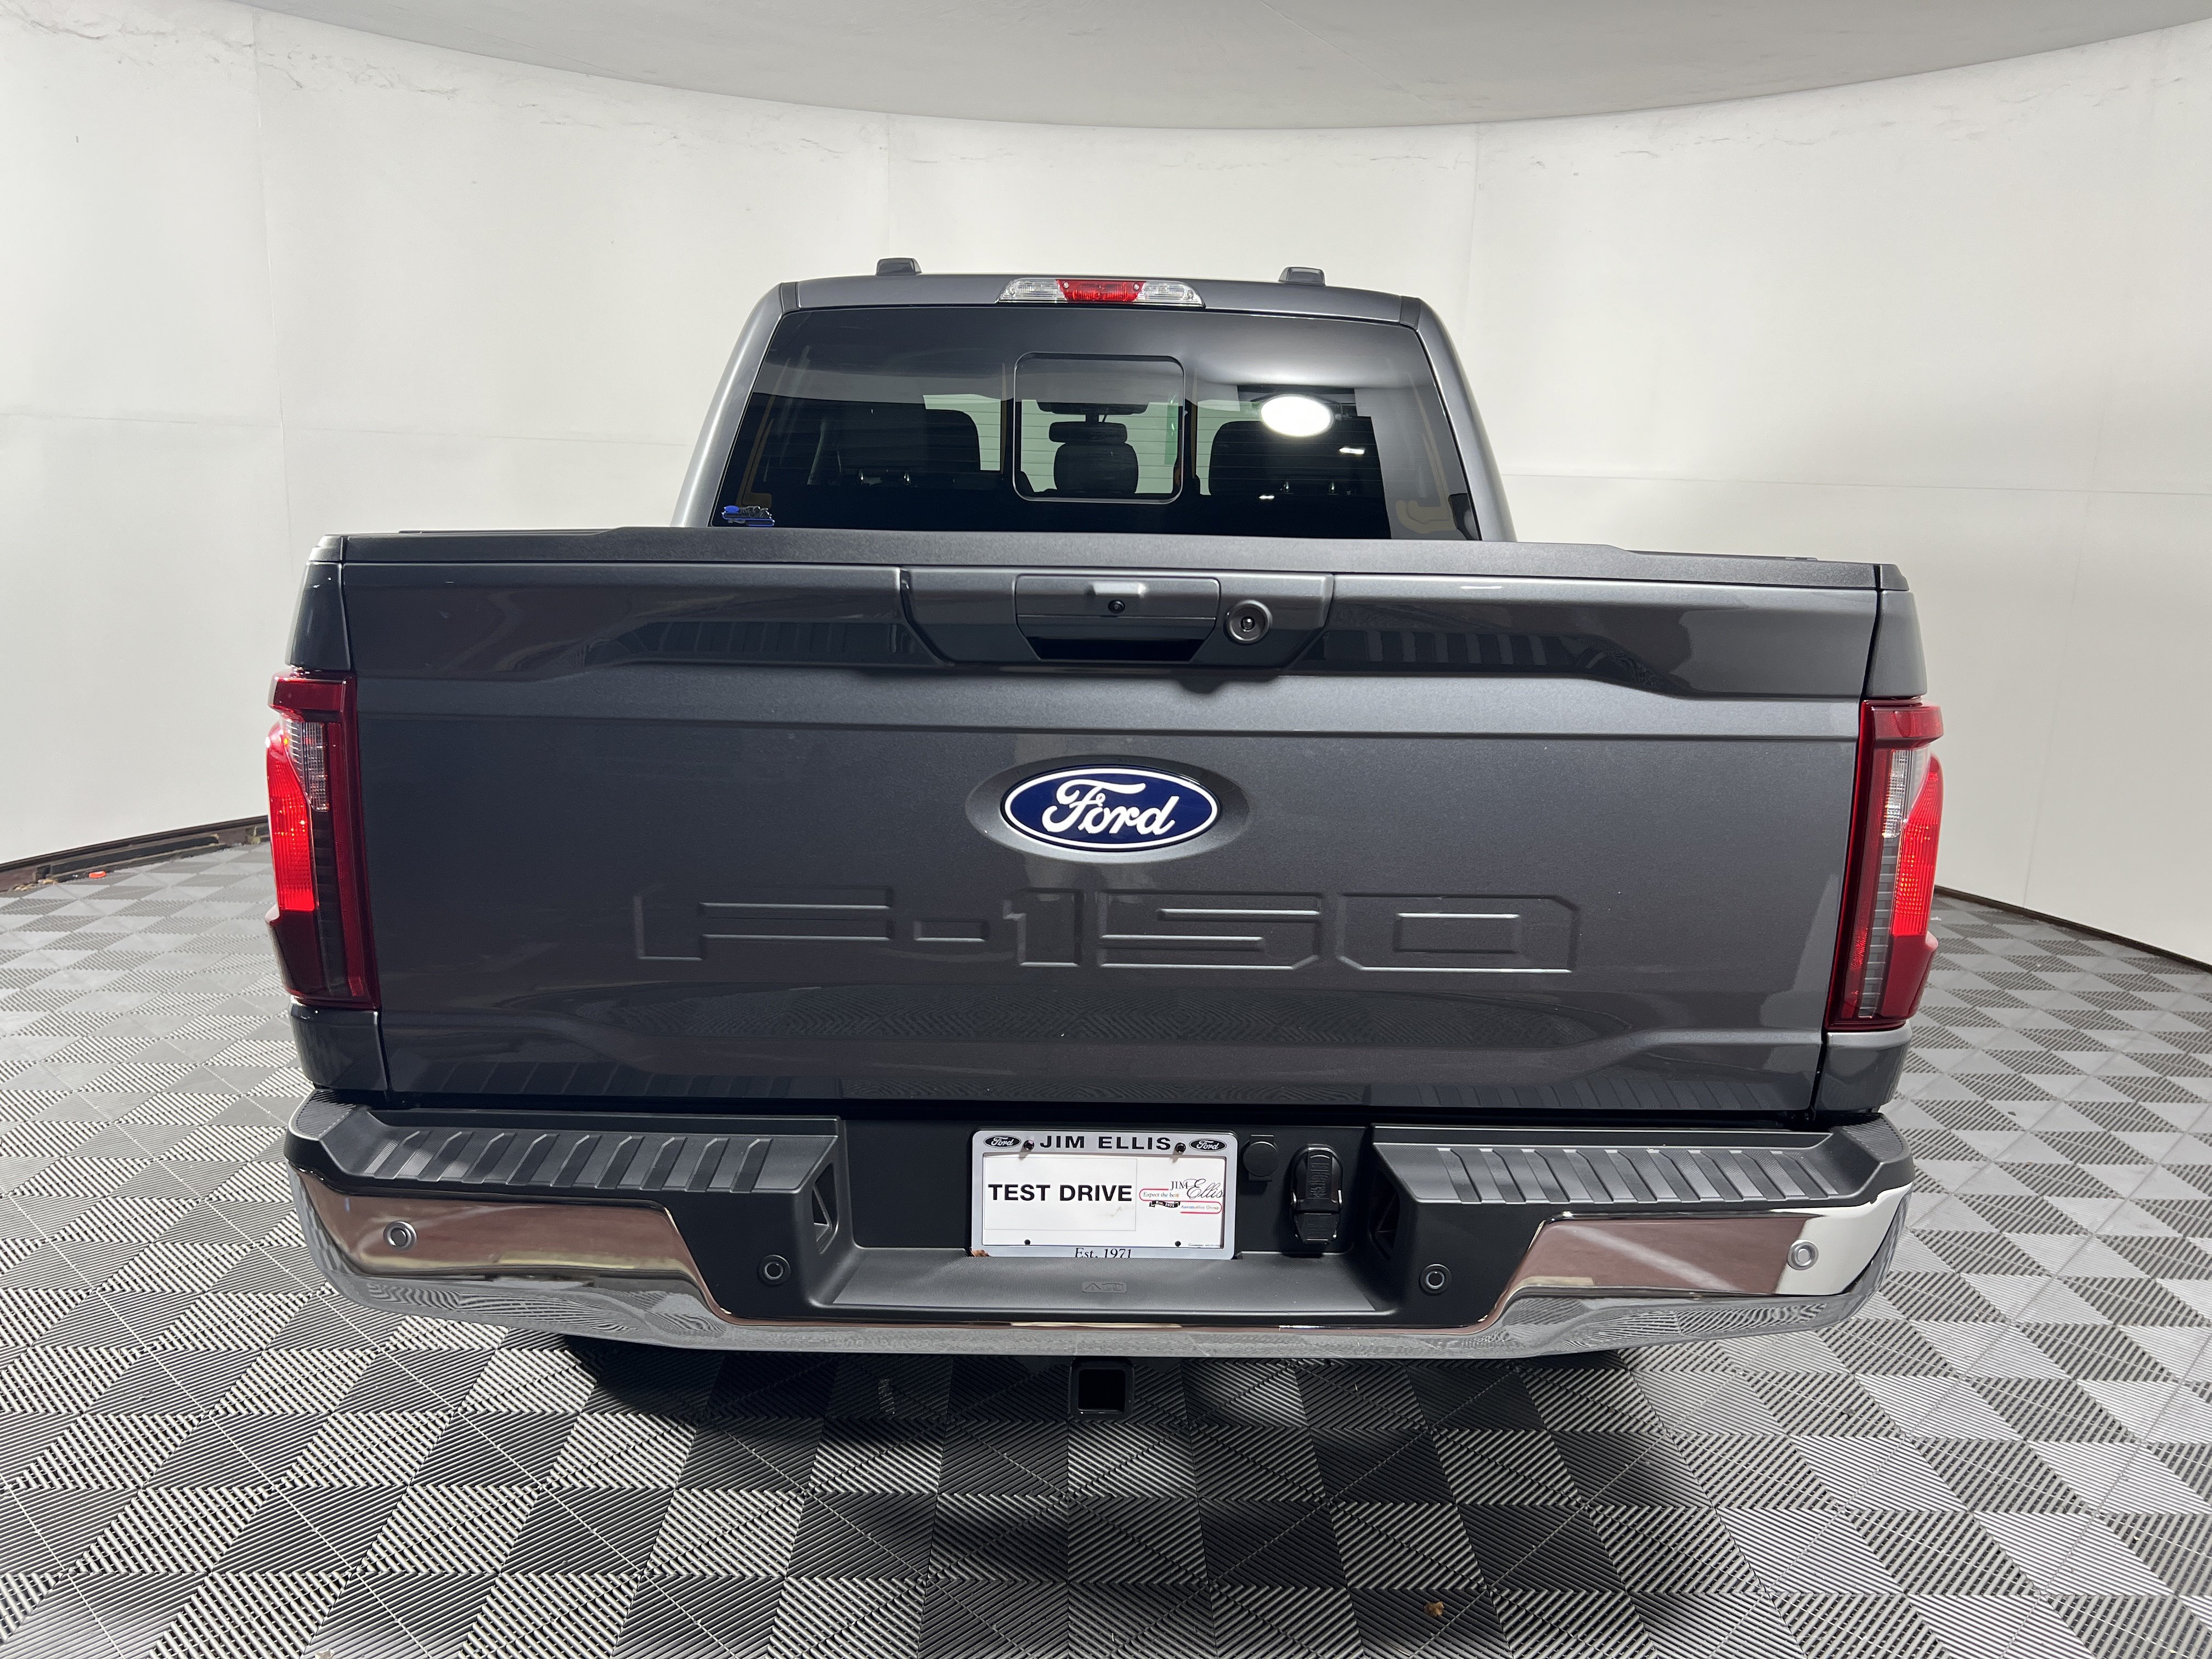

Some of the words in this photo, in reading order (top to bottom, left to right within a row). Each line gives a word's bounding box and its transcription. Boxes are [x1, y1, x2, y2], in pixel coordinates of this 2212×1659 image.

[1042, 779, 1180, 836] Ford
[633, 884, 1581, 974] F-150
[991, 1136, 1015, 1147] Ford
[1040, 1135, 1085, 1149] JIM
[1098, 1136, 1171, 1150] ELLIS
[1195, 1139, 1220, 1151] Ford
[988, 1184, 1051, 1201] TEST
[1059, 1184, 1132, 1202] DRIVE
[1170, 1181, 1189, 1190] JIM
[1183, 1178, 1225, 1199] Ellis
[1075, 1247, 1098, 1259] Est.
[1104, 1248, 1132, 1259] 1971
